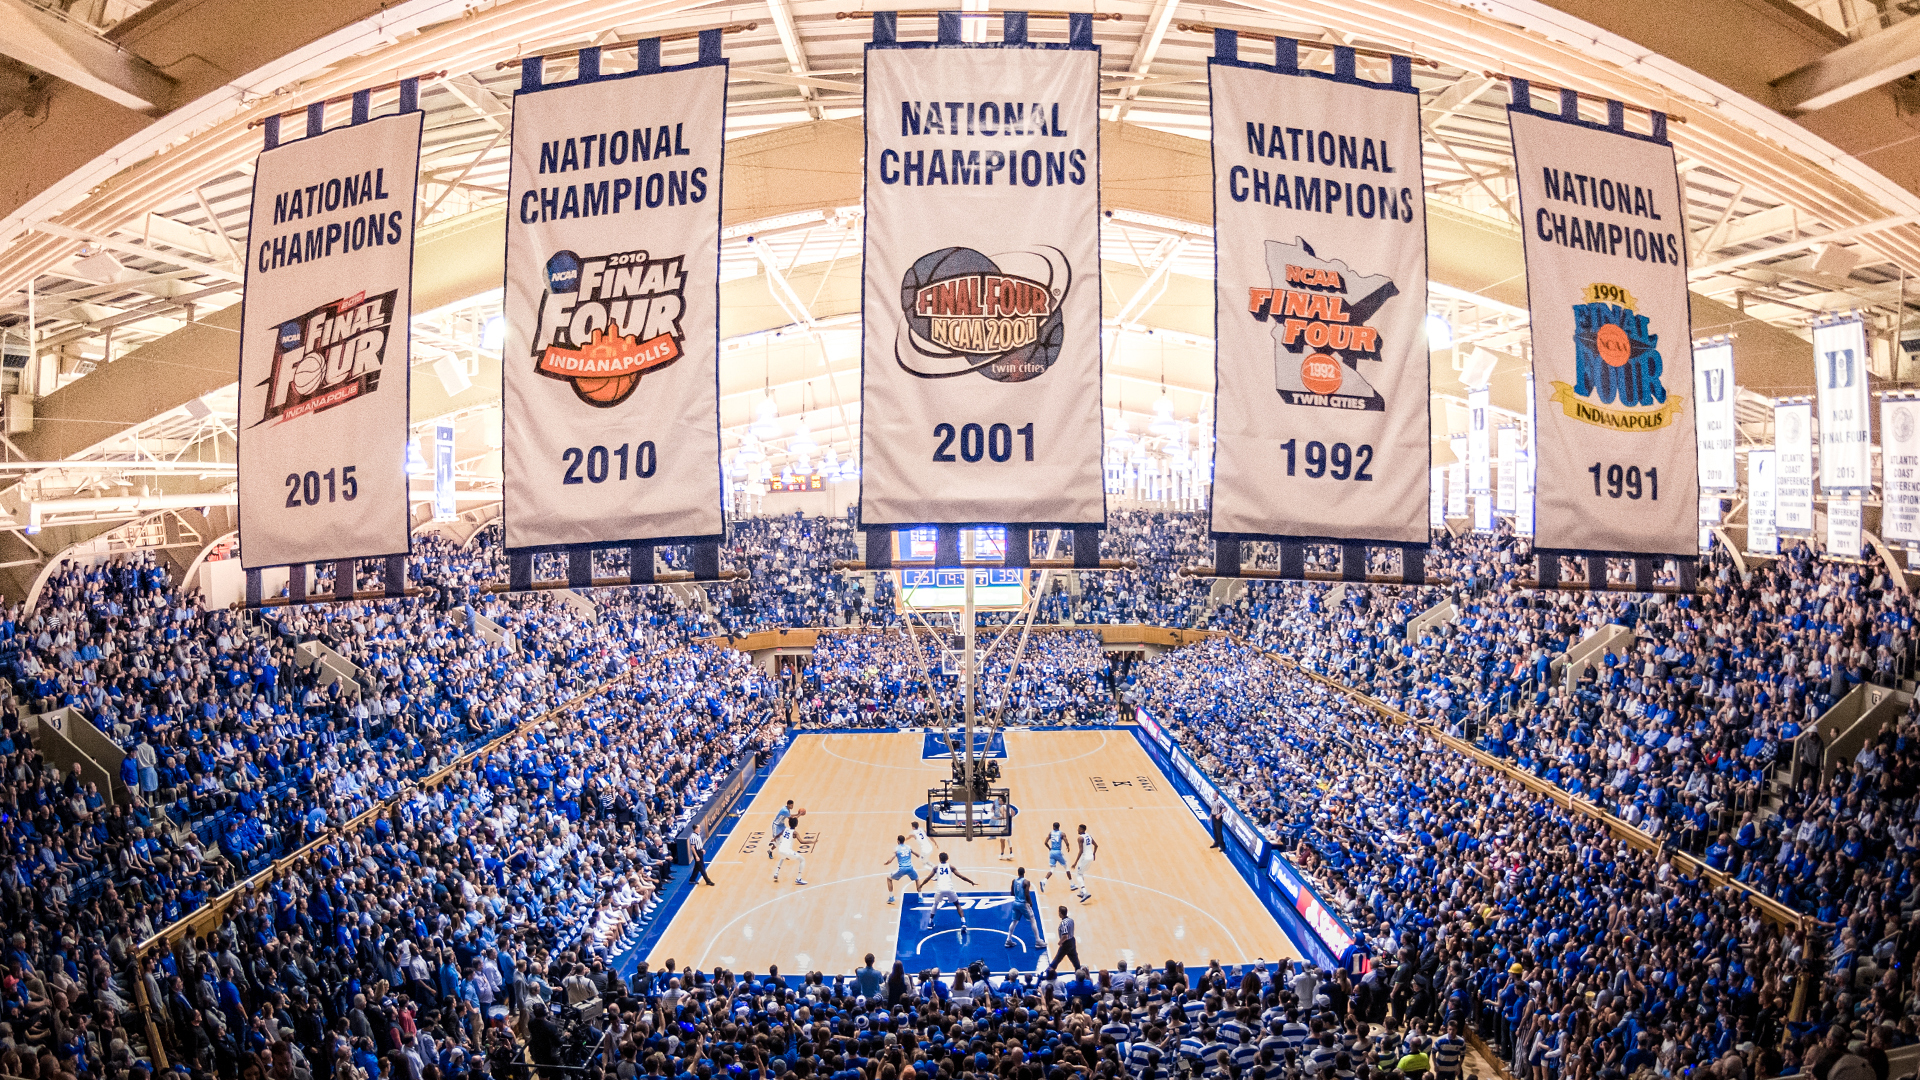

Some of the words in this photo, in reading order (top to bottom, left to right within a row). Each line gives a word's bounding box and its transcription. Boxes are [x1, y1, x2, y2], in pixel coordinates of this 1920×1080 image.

[901, 101, 1067, 137] NATIONAL
[539, 122, 690, 174] NATIONAL
[1246, 121, 1397, 174] NATIONAL
[880, 148, 1086, 187] CHAMPIONS
[273, 168, 389, 225] NATIONAL
[520, 166, 708, 225] CHAMPIONS
[1229, 165, 1413, 224] CHAMPIONS
[1543, 167, 1661, 221] NATIONAL
[258, 210, 403, 273] CHAMPIONS
[1536, 207, 1678, 266] CHAMPIONS
[609, 252, 647, 266] 2010
[551, 270, 577, 282] NCAA
[578, 260, 683, 302] FINAL
[1285, 264, 1343, 290] NCAA
[917, 276, 985, 317] FINAL
[985, 276, 1050, 317] FOUR
[1249, 287, 1350, 322] FINAL
[1593, 285, 1626, 303] 1991
[305, 299, 386, 354] FINAL
[537, 292, 681, 351] FOUR
[932, 318, 986, 351] NCAA
[986, 317, 1037, 351] 2001
[282, 333, 300, 344] NCAA
[1282, 318, 1377, 353] FOUR
[1600, 338, 1628, 352] NCAA
[549, 342, 671, 372] INDIANAPOLIS
[991, 363, 1016, 374] twin
[1018, 362, 1045, 374] cities
[1309, 362, 1335, 379] 1992
[285, 385, 358, 419] INDIANAPOLIS
[1292, 393, 1329, 408] TWIN
[1330, 397, 1365, 410] CITIES
[1576, 403, 1662, 429] INDIANAPOLIS
[1833, 409, 1853, 422] NCAA
[932, 422, 1034, 463] 2001
[1699, 439, 1715, 450] FNAL
[1845, 430, 1868, 442] FOUR
[562, 440, 657, 485] 2010
[1280, 438, 1373, 482] 1992
[1781, 454, 1804, 462] ATLANTIC
[1785, 465, 1801, 474] COAST
[1890, 456, 1918, 466] ATLANTIC
[1588, 462, 1658, 501] 1991
[1777, 477, 1810, 486] CONFERENCE
[1836, 467, 1855, 479] 2015
[1893, 469, 1914, 478] COAST
[285, 465, 358, 509] 2015
[1778, 488, 1809, 497] CHAMPIONS
[1885, 481, 1920, 492] CONFERENC
[1895, 522, 1912, 532] 1992
[742, 831, 766, 854] COACH
[797, 832, 817, 854] CORT
[939, 867, 949, 876] 34
